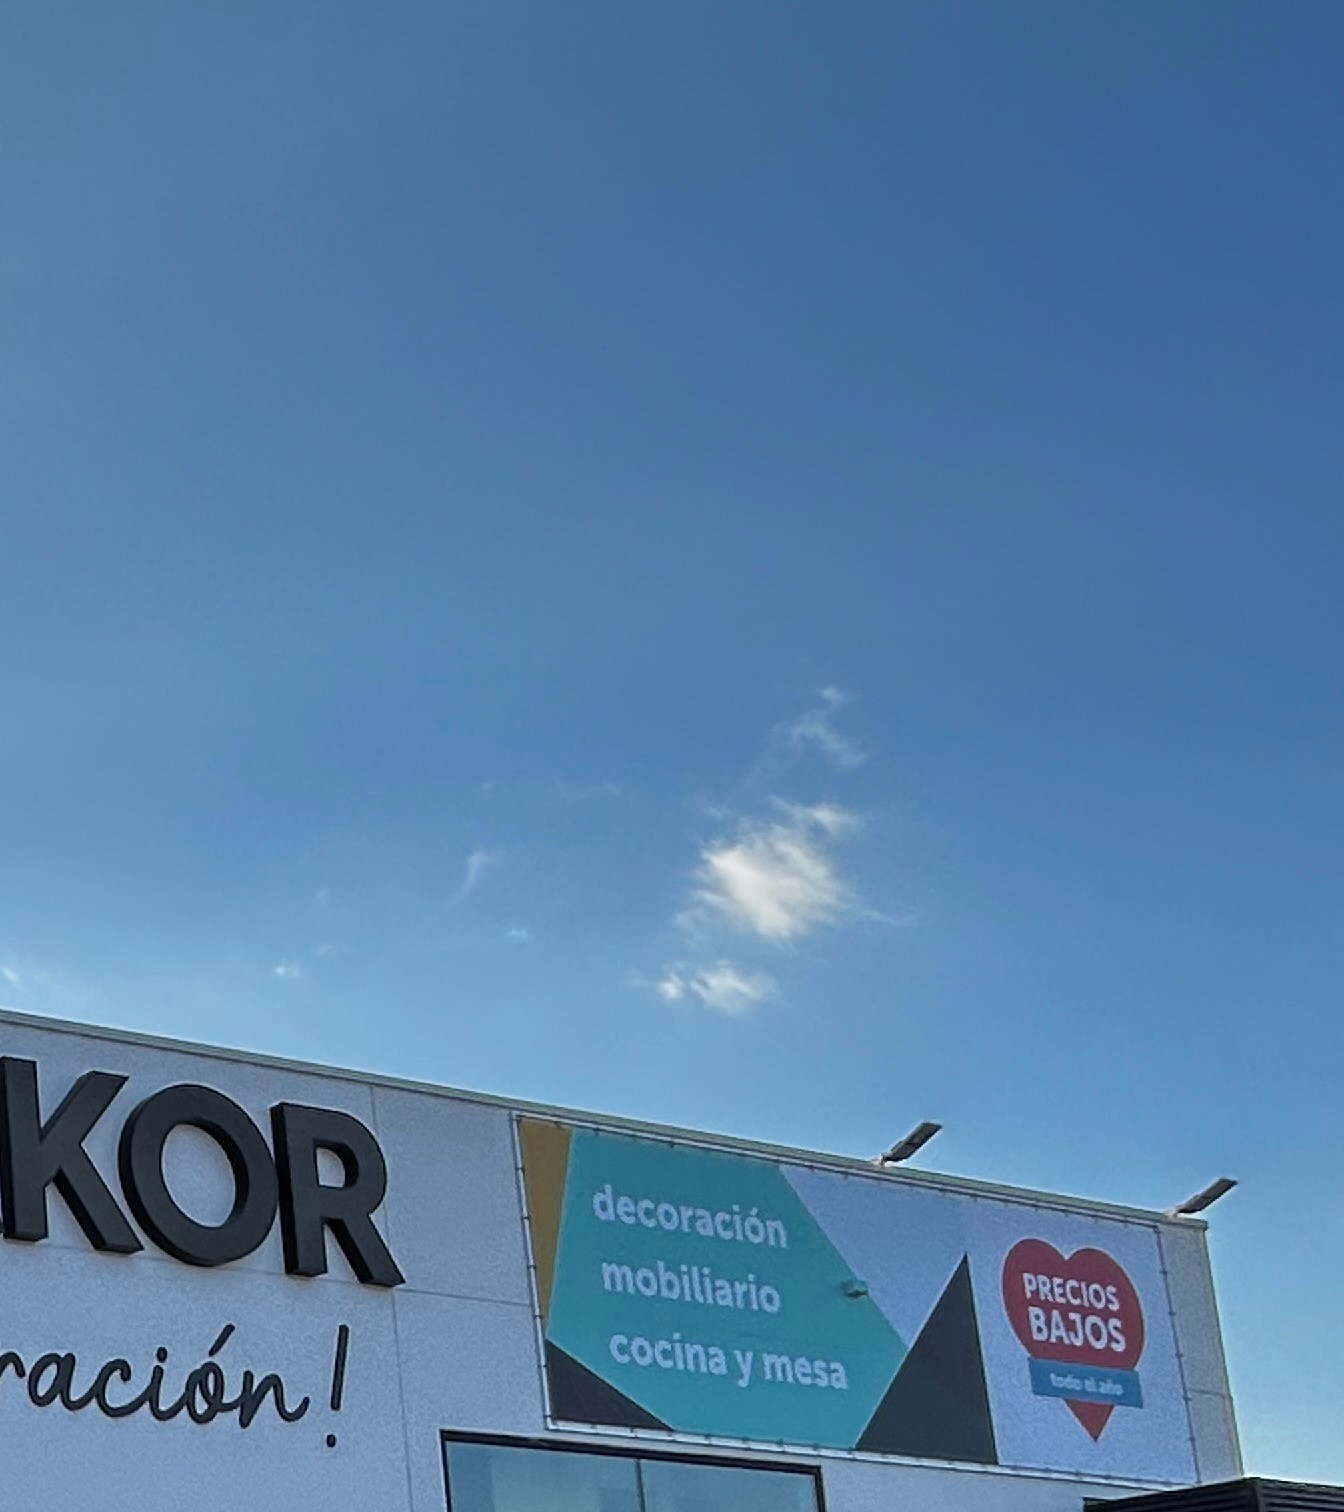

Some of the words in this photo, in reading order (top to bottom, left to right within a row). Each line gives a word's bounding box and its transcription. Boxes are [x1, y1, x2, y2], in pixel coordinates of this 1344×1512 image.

[592, 1184, 787, 1248] decoración
[602, 1261, 781, 1313] mobiliario
[1022, 1272, 1120, 1312] PRECIOS
[1028, 1306, 1126, 1352] BAJOS
[609, 1332, 728, 1376] cocina
[733, 1350, 754, 1388] y
[762, 1352, 849, 1390] mesa
